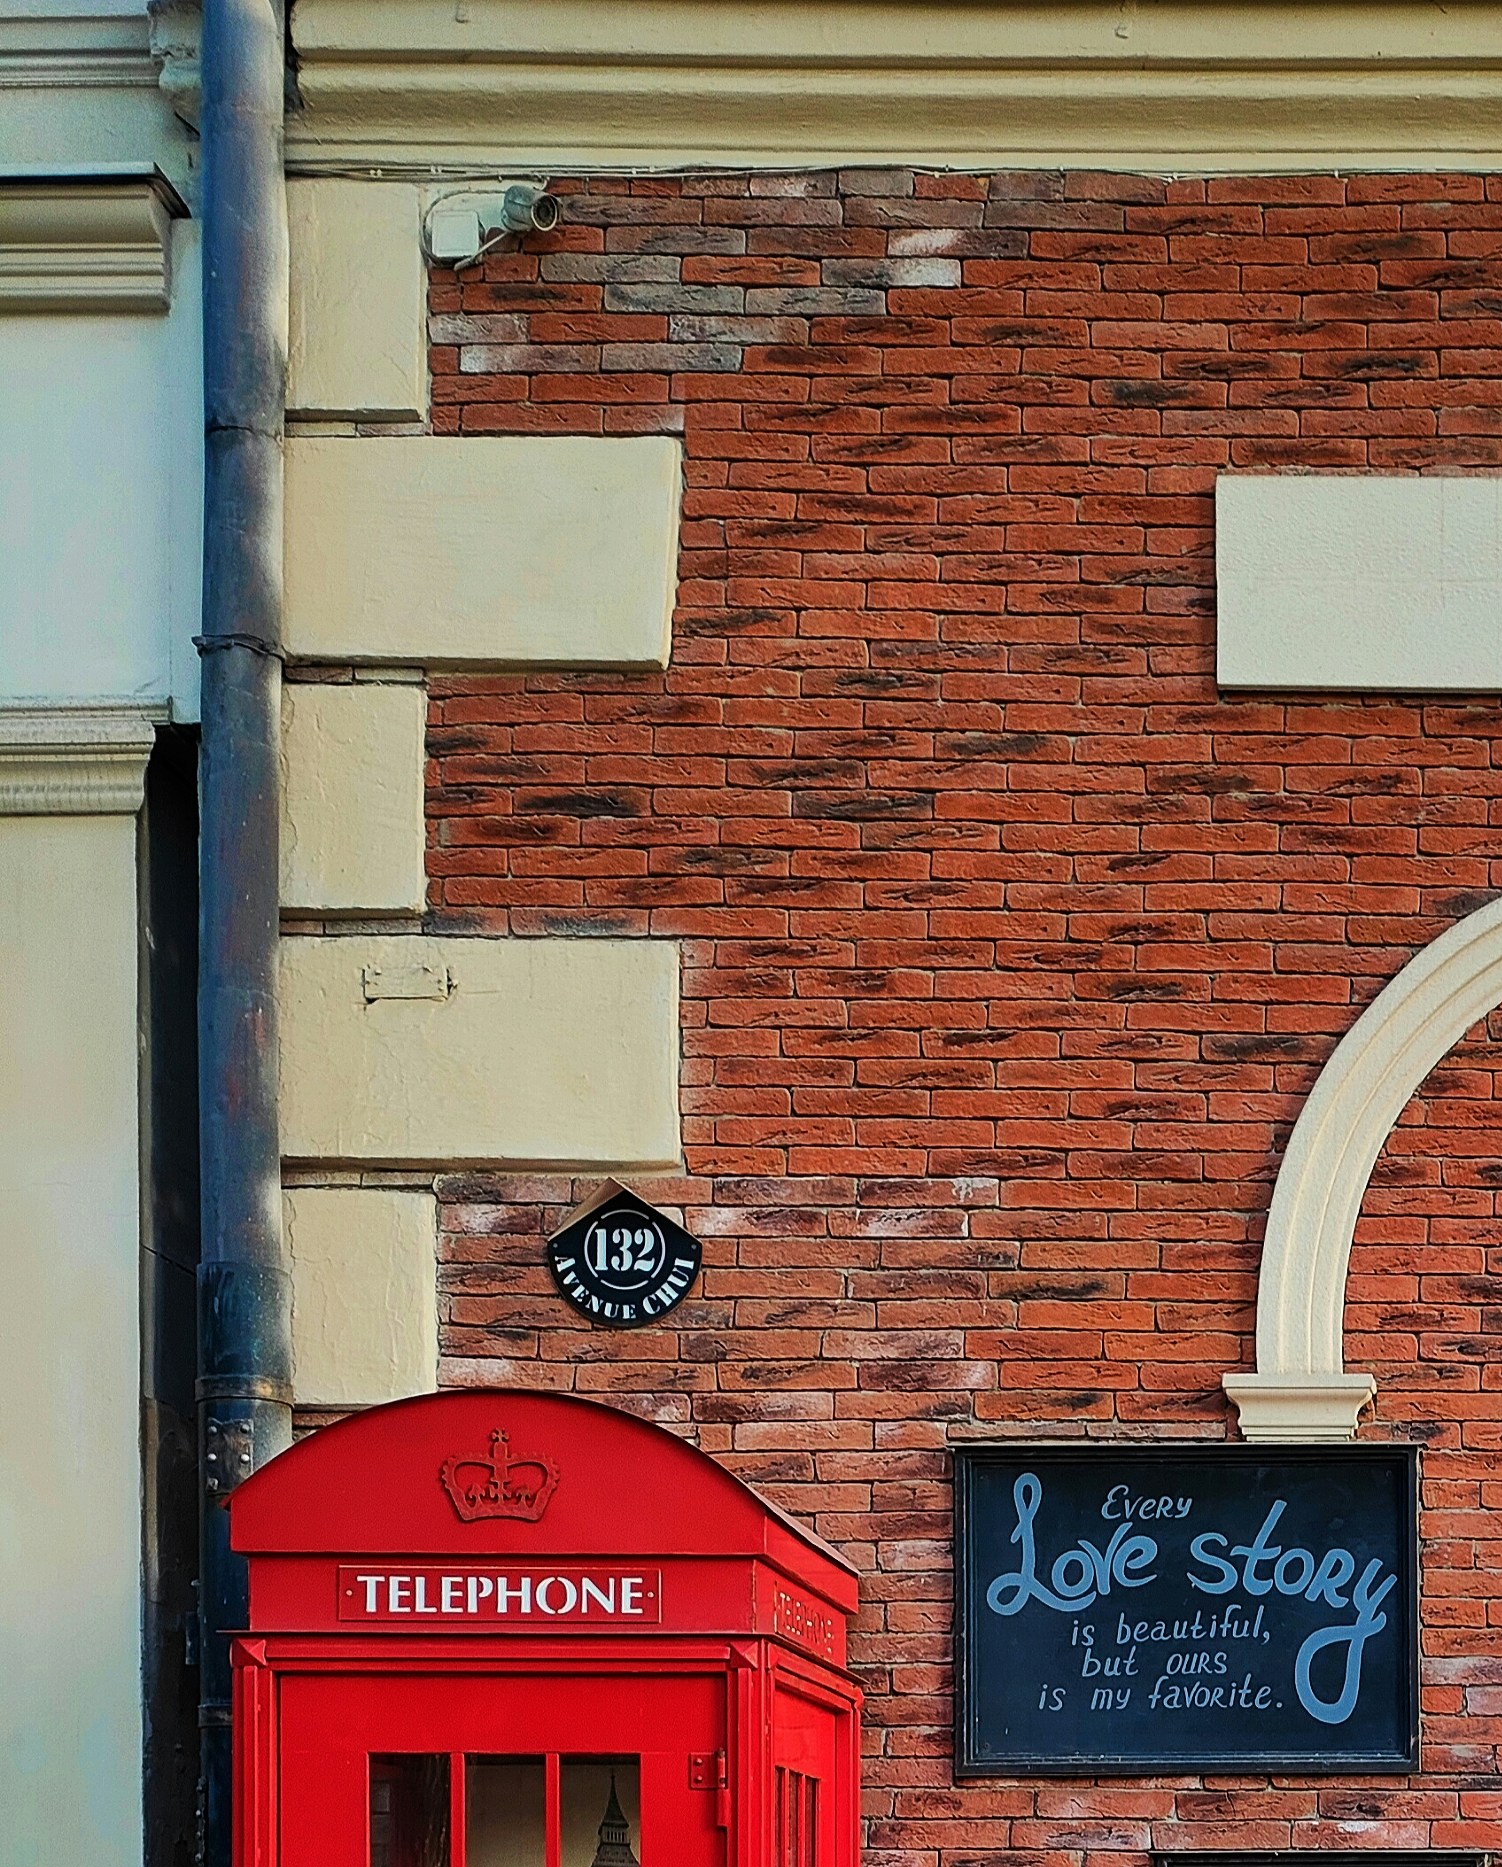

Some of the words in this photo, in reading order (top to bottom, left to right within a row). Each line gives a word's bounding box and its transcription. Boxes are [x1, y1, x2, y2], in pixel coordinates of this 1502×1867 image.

[595, 1228, 655, 1271] 132
[555, 1256, 637, 1319] AVENUE
[642, 1257, 695, 1315] CHUI
[986, 1472, 1158, 1616] Love
[357, 1576, 643, 1614] TELEPHONE
[1072, 1619, 1095, 1646] is
[1117, 1605, 1271, 1645] beautiful,
[1082, 1648, 1138, 1677] but
[1038, 1684, 1066, 1711] is
[1091, 1688, 1131, 1711] my
[1148, 1674, 1284, 1710] favorite.
